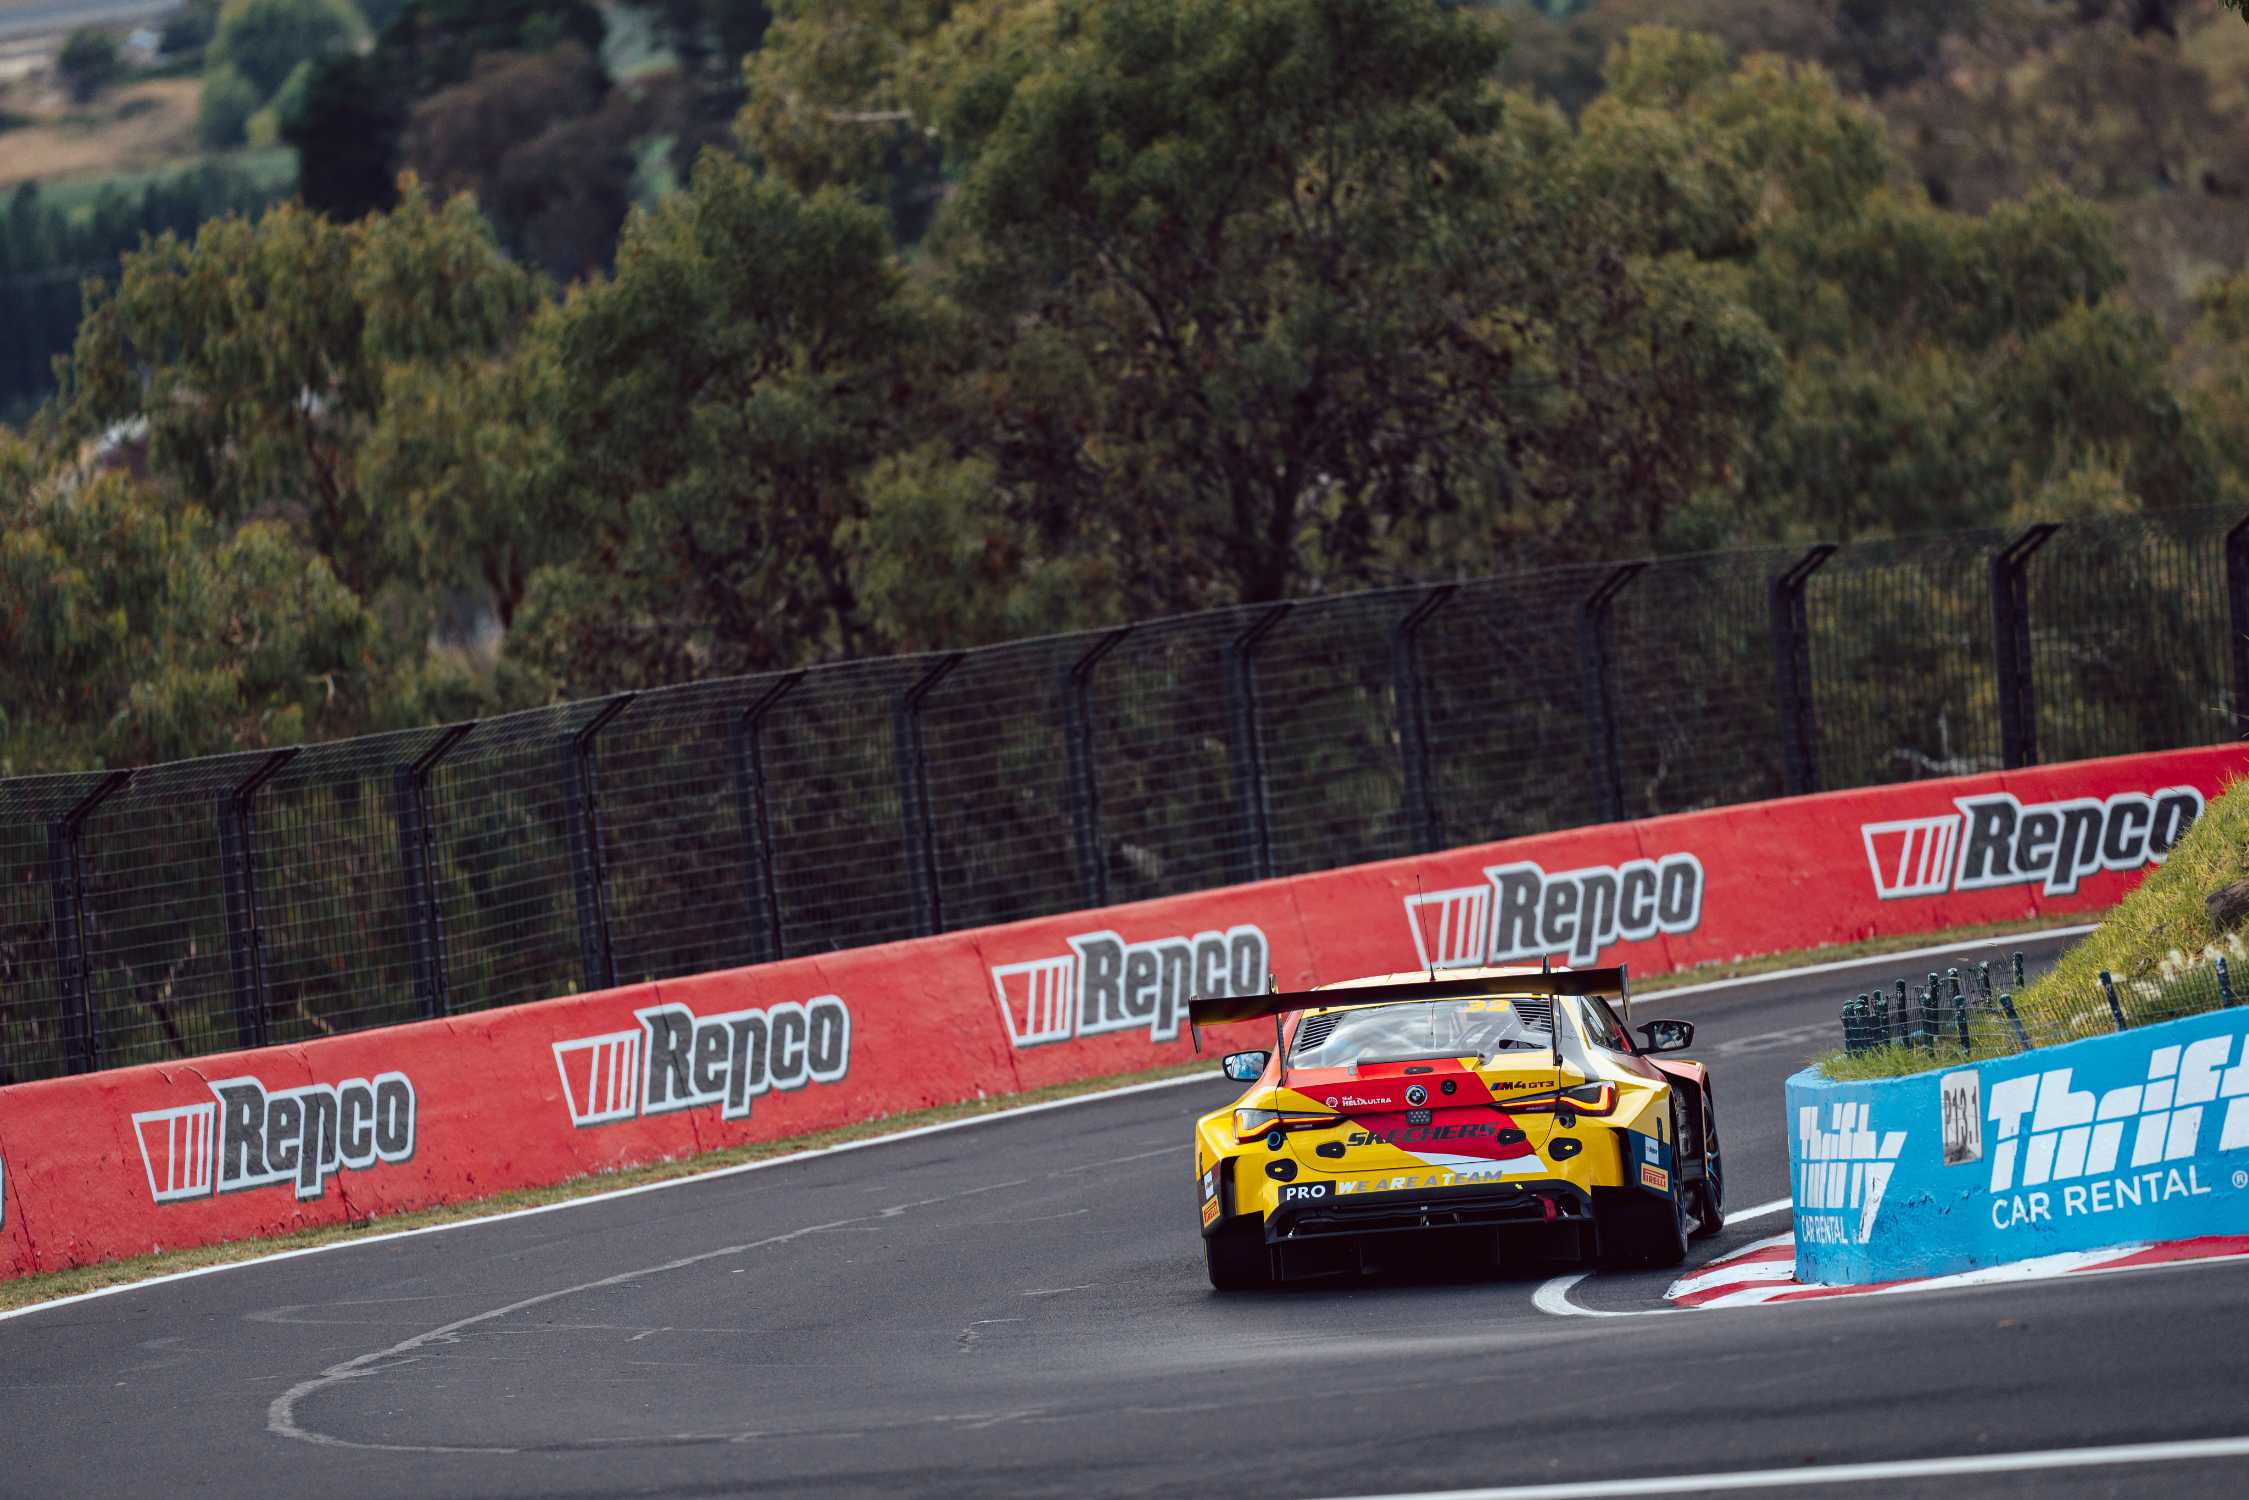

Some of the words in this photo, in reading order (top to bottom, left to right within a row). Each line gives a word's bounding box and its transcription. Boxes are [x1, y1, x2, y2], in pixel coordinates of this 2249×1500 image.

[1955, 787, 2203, 895] Repco
[1485, 853, 1703, 966] Repco
[1067, 925, 1268, 1040] Repco
[636, 995, 850, 1119] Repco
[209, 1072, 415, 1199] Repco
[1338, 1179, 1369, 1195] WE
[1374, 1175, 1419, 1192] ARE
[1423, 1174, 1440, 1187] A
[1441, 1170, 1503, 1185] TEAM
[1347, 1120, 1497, 1147] SKECHERS
[1800, 1102, 1907, 1244] Thrifty
[1286, 1185, 1326, 1200] PRO
[1815, 1215, 1849, 1245] RENTAL
[1992, 1194, 2051, 1230] CAR
[2064, 1165, 2212, 1217] RENTAL
